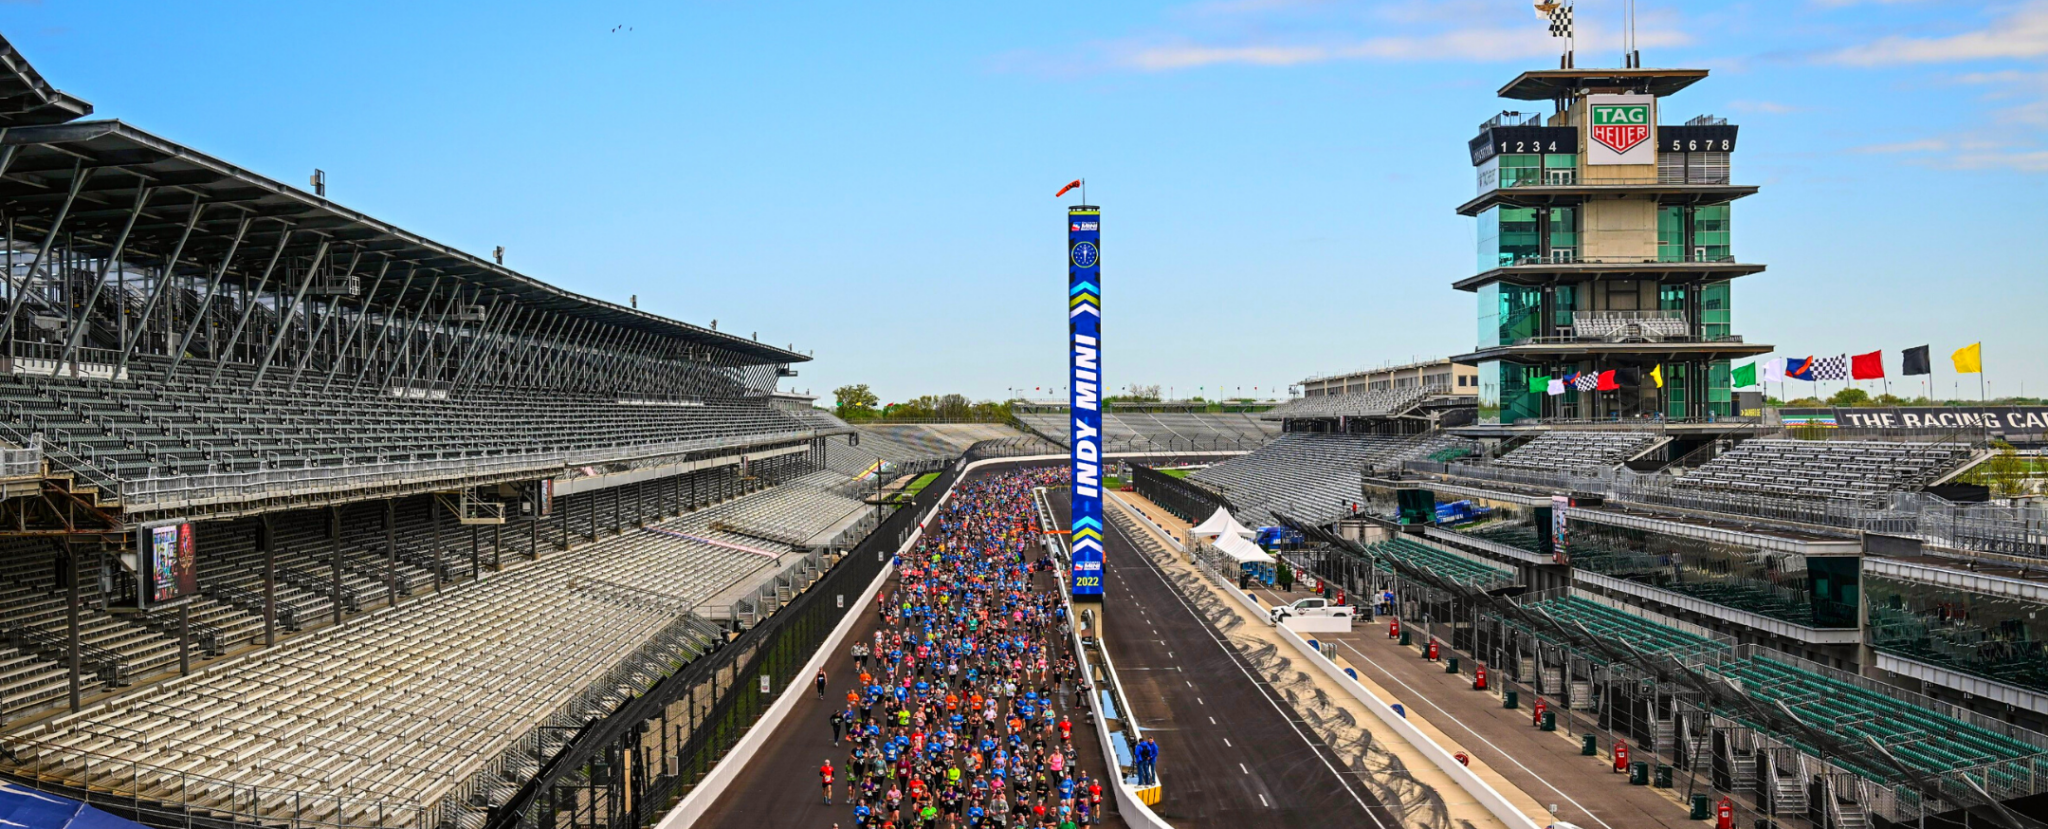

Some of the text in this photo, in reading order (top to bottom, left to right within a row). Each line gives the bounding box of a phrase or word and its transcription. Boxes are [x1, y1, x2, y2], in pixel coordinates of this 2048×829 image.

[1596, 107, 1644, 123] TAG
[1595, 126, 1646, 149] HEUER
[1672, 139, 1730, 151] 5 6 7 8
[1500, 141, 1507, 153] 1
[1516, 141, 1524, 153] 2
[1532, 141, 1540, 152] 3
[1548, 141, 1557, 152] 4
[1075, 333, 1098, 498] INDY MINI
[1845, 412, 1898, 429] THE
[1902, 412, 2001, 429] RACING
[1076, 576, 1099, 586] 2022
